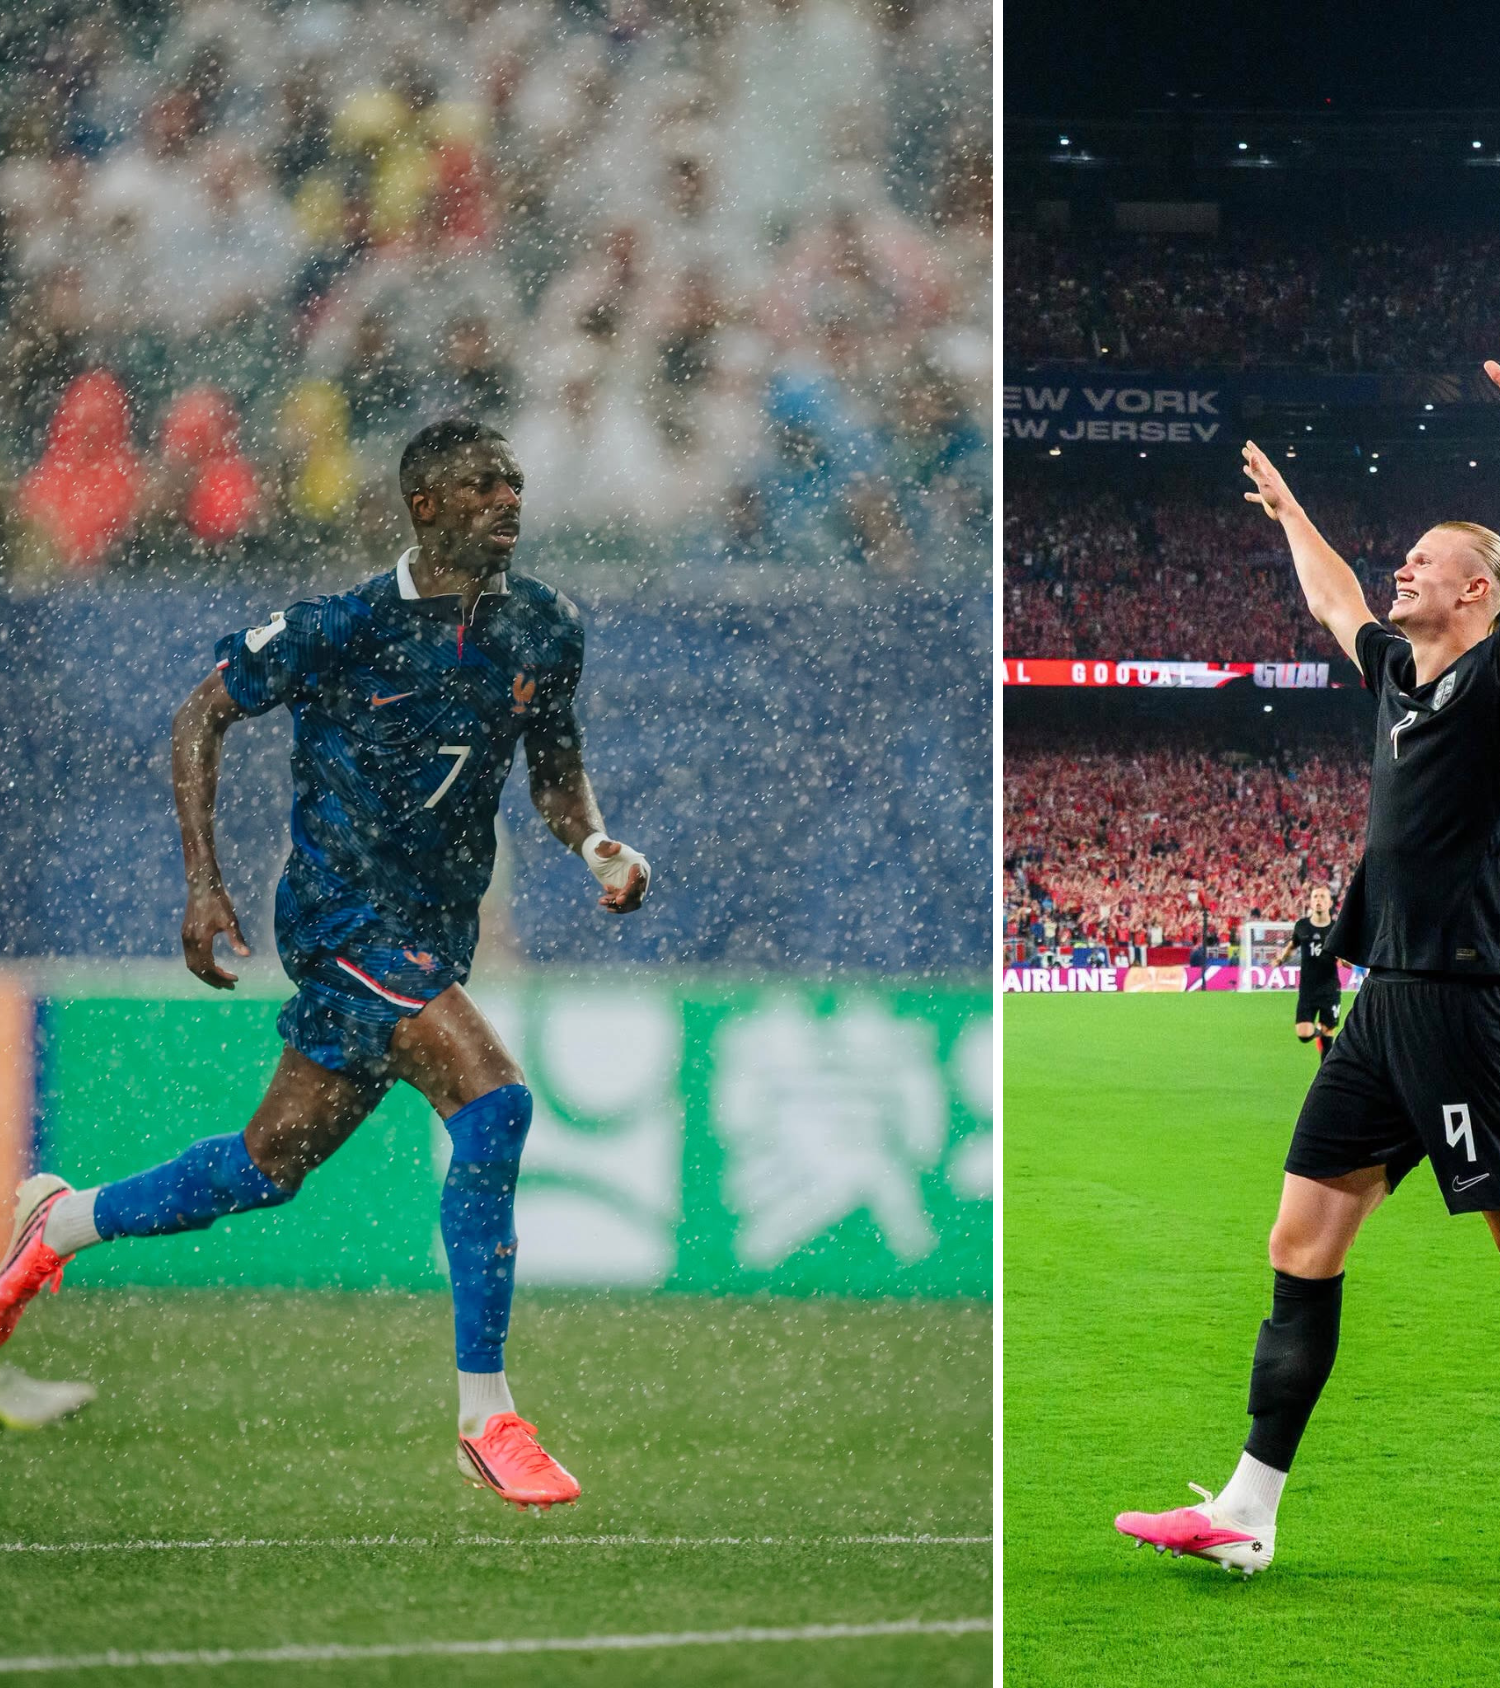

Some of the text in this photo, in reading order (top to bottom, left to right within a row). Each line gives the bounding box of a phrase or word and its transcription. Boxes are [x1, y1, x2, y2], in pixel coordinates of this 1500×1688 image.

[1082, 387, 1219, 414] YORK
[1059, 420, 1220, 442] JERSEY
[1072, 662, 1193, 686] GOOOAL
[423, 745, 471, 809] 7
[1309, 942, 1322, 957] 16
[1003, 968, 1117, 992] AIRLINE
[1442, 1103, 1477, 1162] 9
